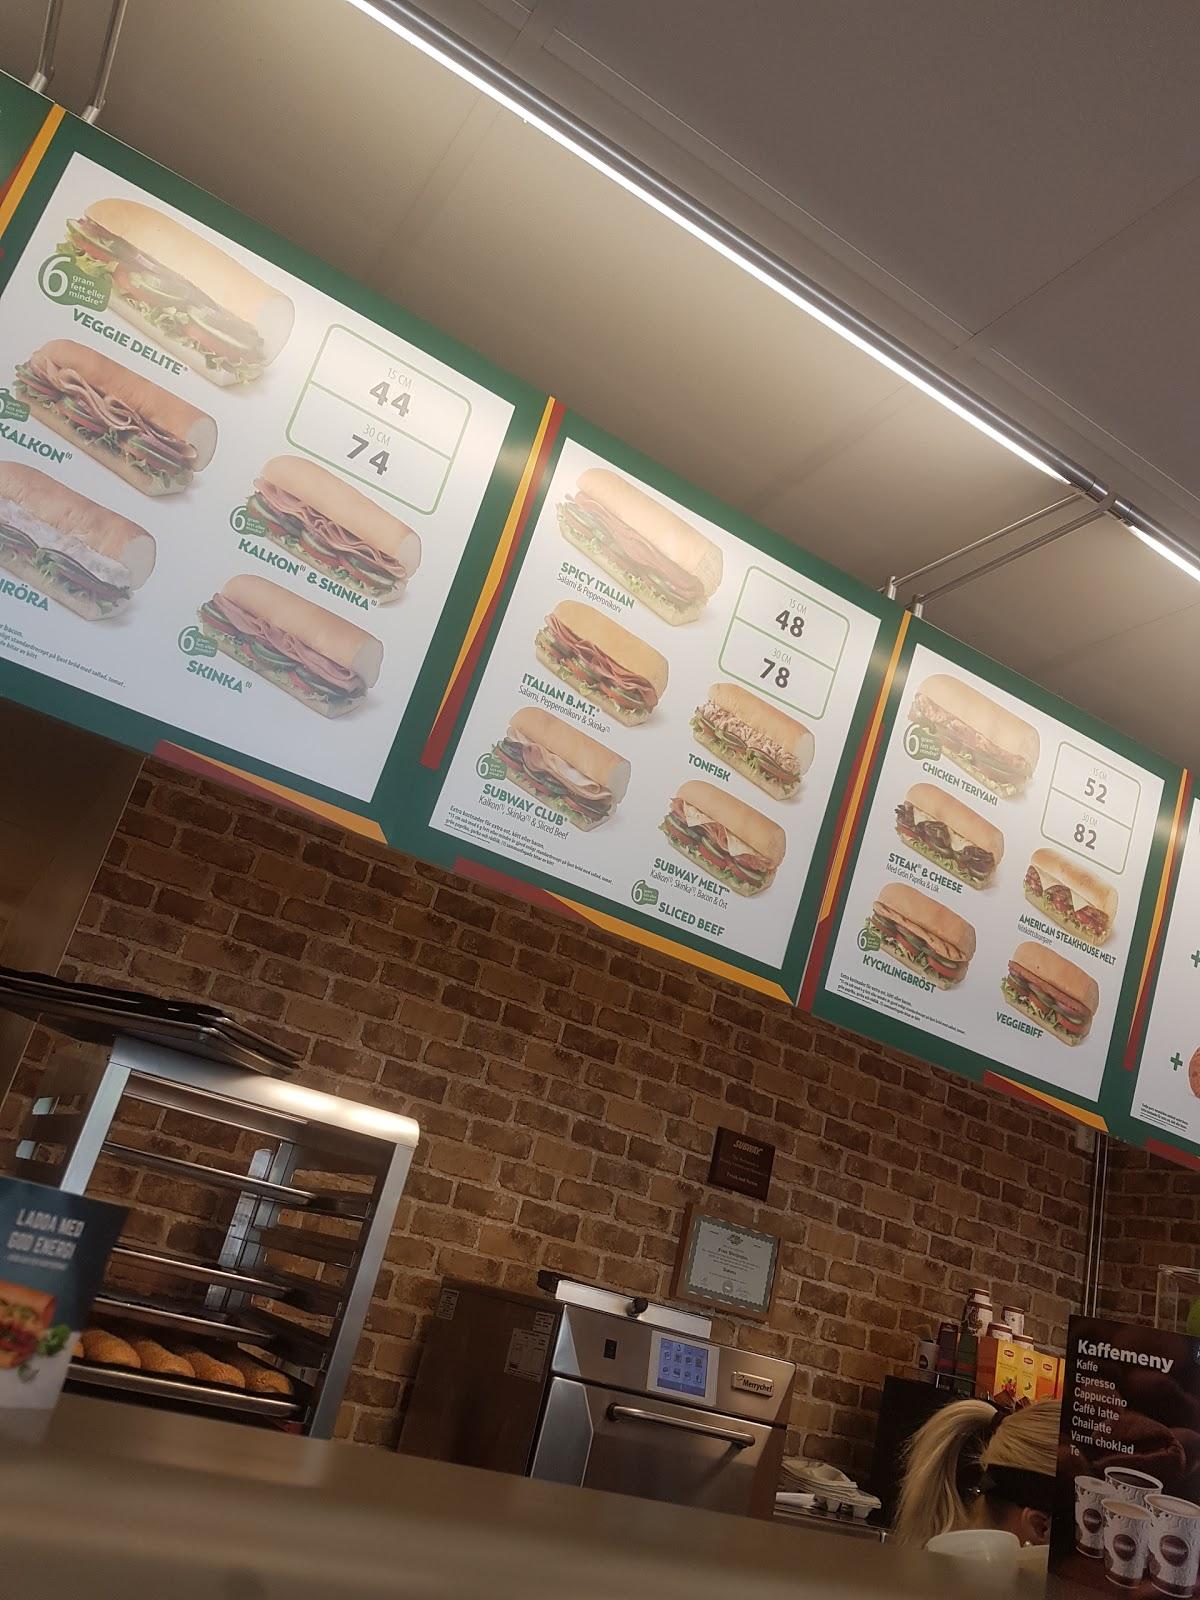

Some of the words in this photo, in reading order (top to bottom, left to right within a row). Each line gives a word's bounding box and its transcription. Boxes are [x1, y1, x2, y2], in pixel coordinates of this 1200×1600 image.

[43, 256, 71, 297] 6
[72, 274, 95, 288] gram
[70, 282, 86, 294] fett
[87, 288, 106, 301] eller
[72, 308, 131, 348] VEGGIE
[386, 367, 397, 379] 15
[398, 374, 412, 389] CM
[369, 381, 411, 418] 44
[363, 424, 376, 438] 30
[376, 431, 391, 447] CM
[346, 433, 390, 476] 74
[232, 507, 247, 531] 6
[306, 572, 318, 585] &
[560, 562, 595, 586] SPICY
[594, 579, 635, 610] ITALIAN
[557, 572, 577, 590] Salami
[576, 583, 583, 592] &
[582, 586, 623, 613] Pepperonikorv
[796, 603, 807, 616] CM
[775, 609, 805, 638] 48
[180, 627, 196, 652] 6
[781, 653, 792, 665] CM
[760, 657, 790, 689] 78
[522, 673, 566, 702] ITALIAN
[519, 684, 541, 704] Salami,
[540, 695, 581, 721] Pepperonikorv
[581, 715, 588, 724] &
[905, 724, 920, 756] 6
[479, 754, 492, 777] 6
[688, 753, 731, 782] TONFISK
[922, 762, 961, 787] CHICKEN
[960, 780, 998, 806] TERIYAKI
[1084, 777, 1107, 805] 52
[482, 783, 535, 813] SUBWAY
[530, 818, 537, 828] &
[537, 820, 555, 836] Sliced
[553, 826, 570, 840] Beef
[1073, 823, 1097, 851] 82
[653, 858, 698, 884] SUBWAY
[886, 863, 898, 874] Med
[897, 868, 909, 879] Grön
[908, 873, 926, 887] Paprika
[921, 867, 928, 878] &
[929, 872, 963, 894] CHEESE
[632, 880, 645, 902] 6
[658, 902, 696, 925] SLICED
[696, 917, 725, 936] BEEF
[696, 889, 713, 903] Bacon
[713, 896, 719, 906] &
[859, 930, 868, 949] 6
[1018, 914, 1056, 938] AMERICAN
[1055, 930, 1101, 959] STEAKHOUSE
[1100, 952, 1116, 966] MELT
[862, 954, 937, 994] KYCKLINGBRÖST
[996, 1011, 1044, 1039] VEGGIEBIFF
[1076, 1359, 1099, 1372] Kaffe
[1077, 1339, 1175, 1373] Kaffemeny
[742, 1378, 773, 1393] Merrychef
[1075, 1373, 1116, 1390] Espresso
[1074, 1387, 1128, 1408] Cappuccino
[1073, 1402, 1096, 1415] Caffè
[1098, 1406, 1120, 1421] latte
[1071, 1416, 1112, 1435] Chailatte
[1070, 1445, 1080, 1457] Te
[1071, 1430, 1094, 1445] Varm
[1095, 1437, 1135, 1455] choklad
